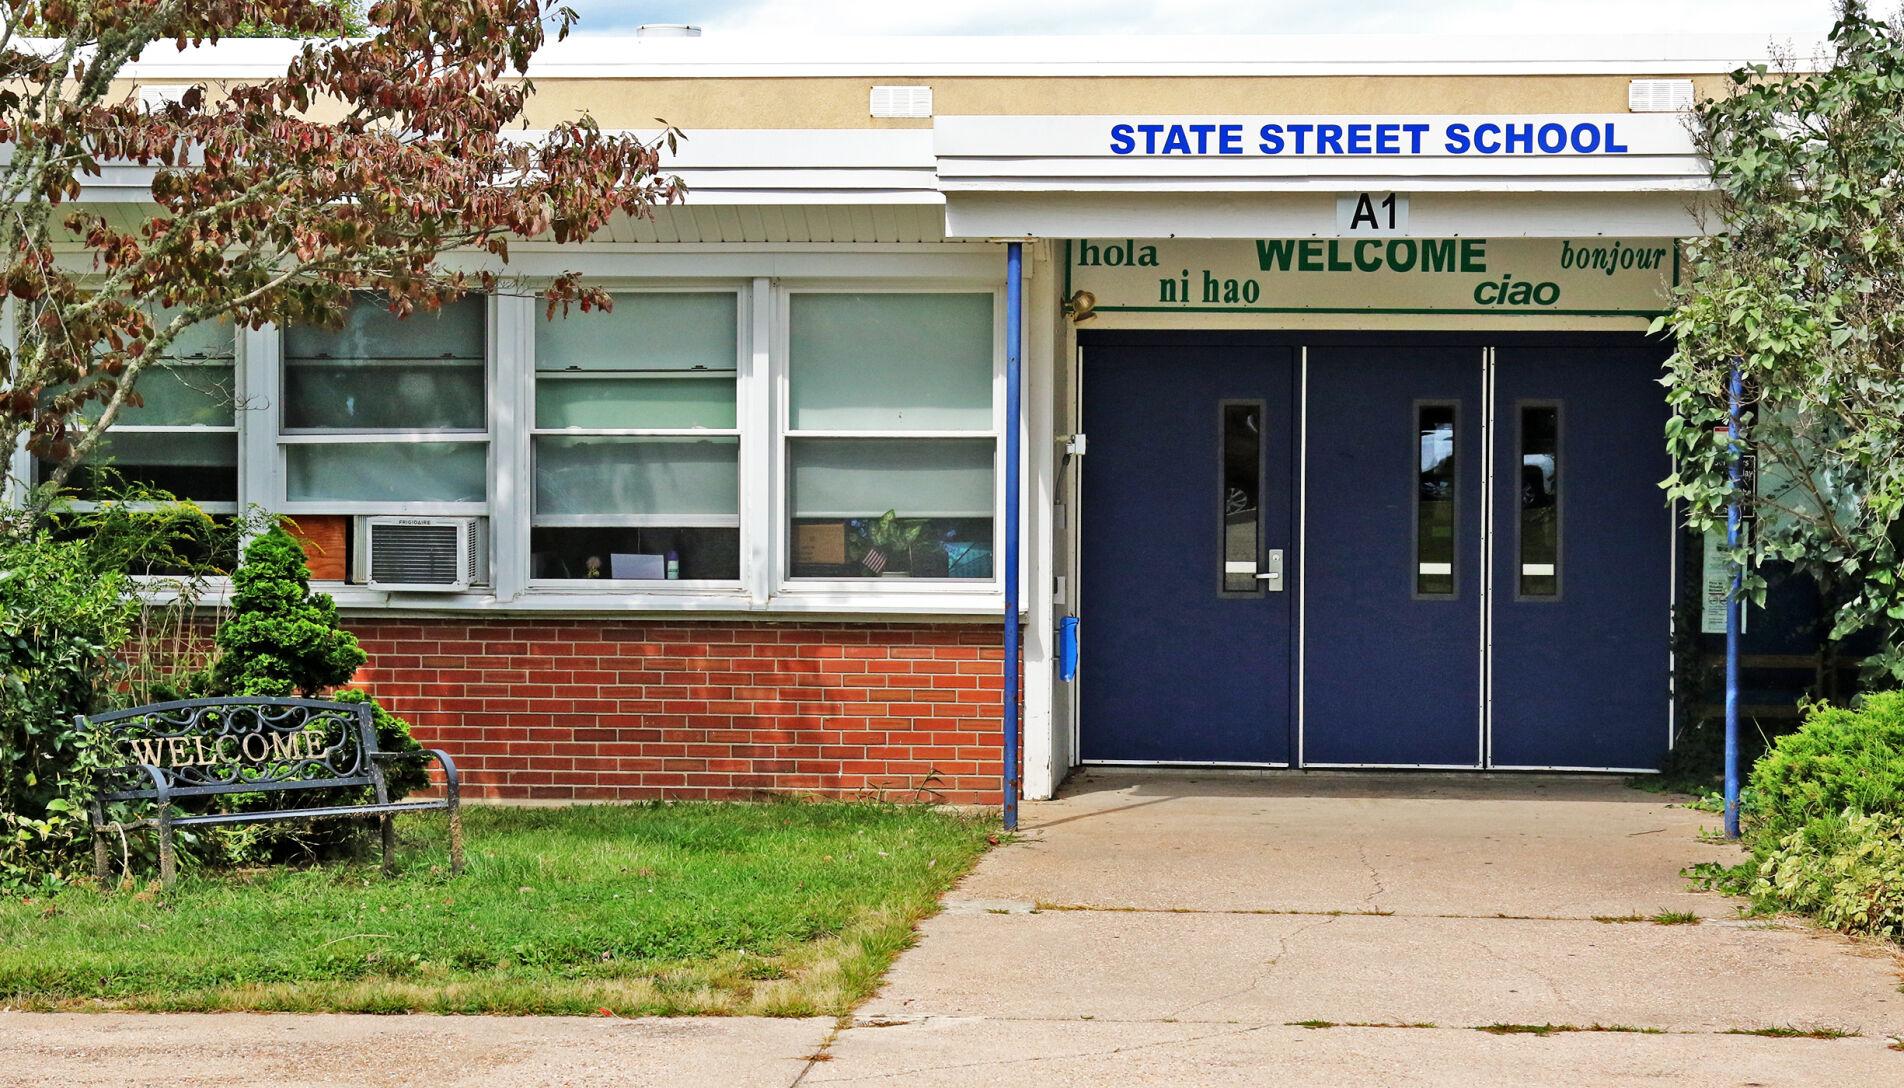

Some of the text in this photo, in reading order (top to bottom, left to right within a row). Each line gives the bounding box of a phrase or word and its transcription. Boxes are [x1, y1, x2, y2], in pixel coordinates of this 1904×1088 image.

[1110, 123, 1628, 155] STATE STREET SCHOOL
[1350, 192, 1396, 229] A1
[1078, 239, 1159, 267] hola
[1255, 239, 1487, 272] WELCOME
[1560, 241, 1667, 276] bonjour
[1159, 269, 1261, 303] ni hao
[1473, 274, 1560, 306] ciao
[131, 730, 329, 767] WELCOME
